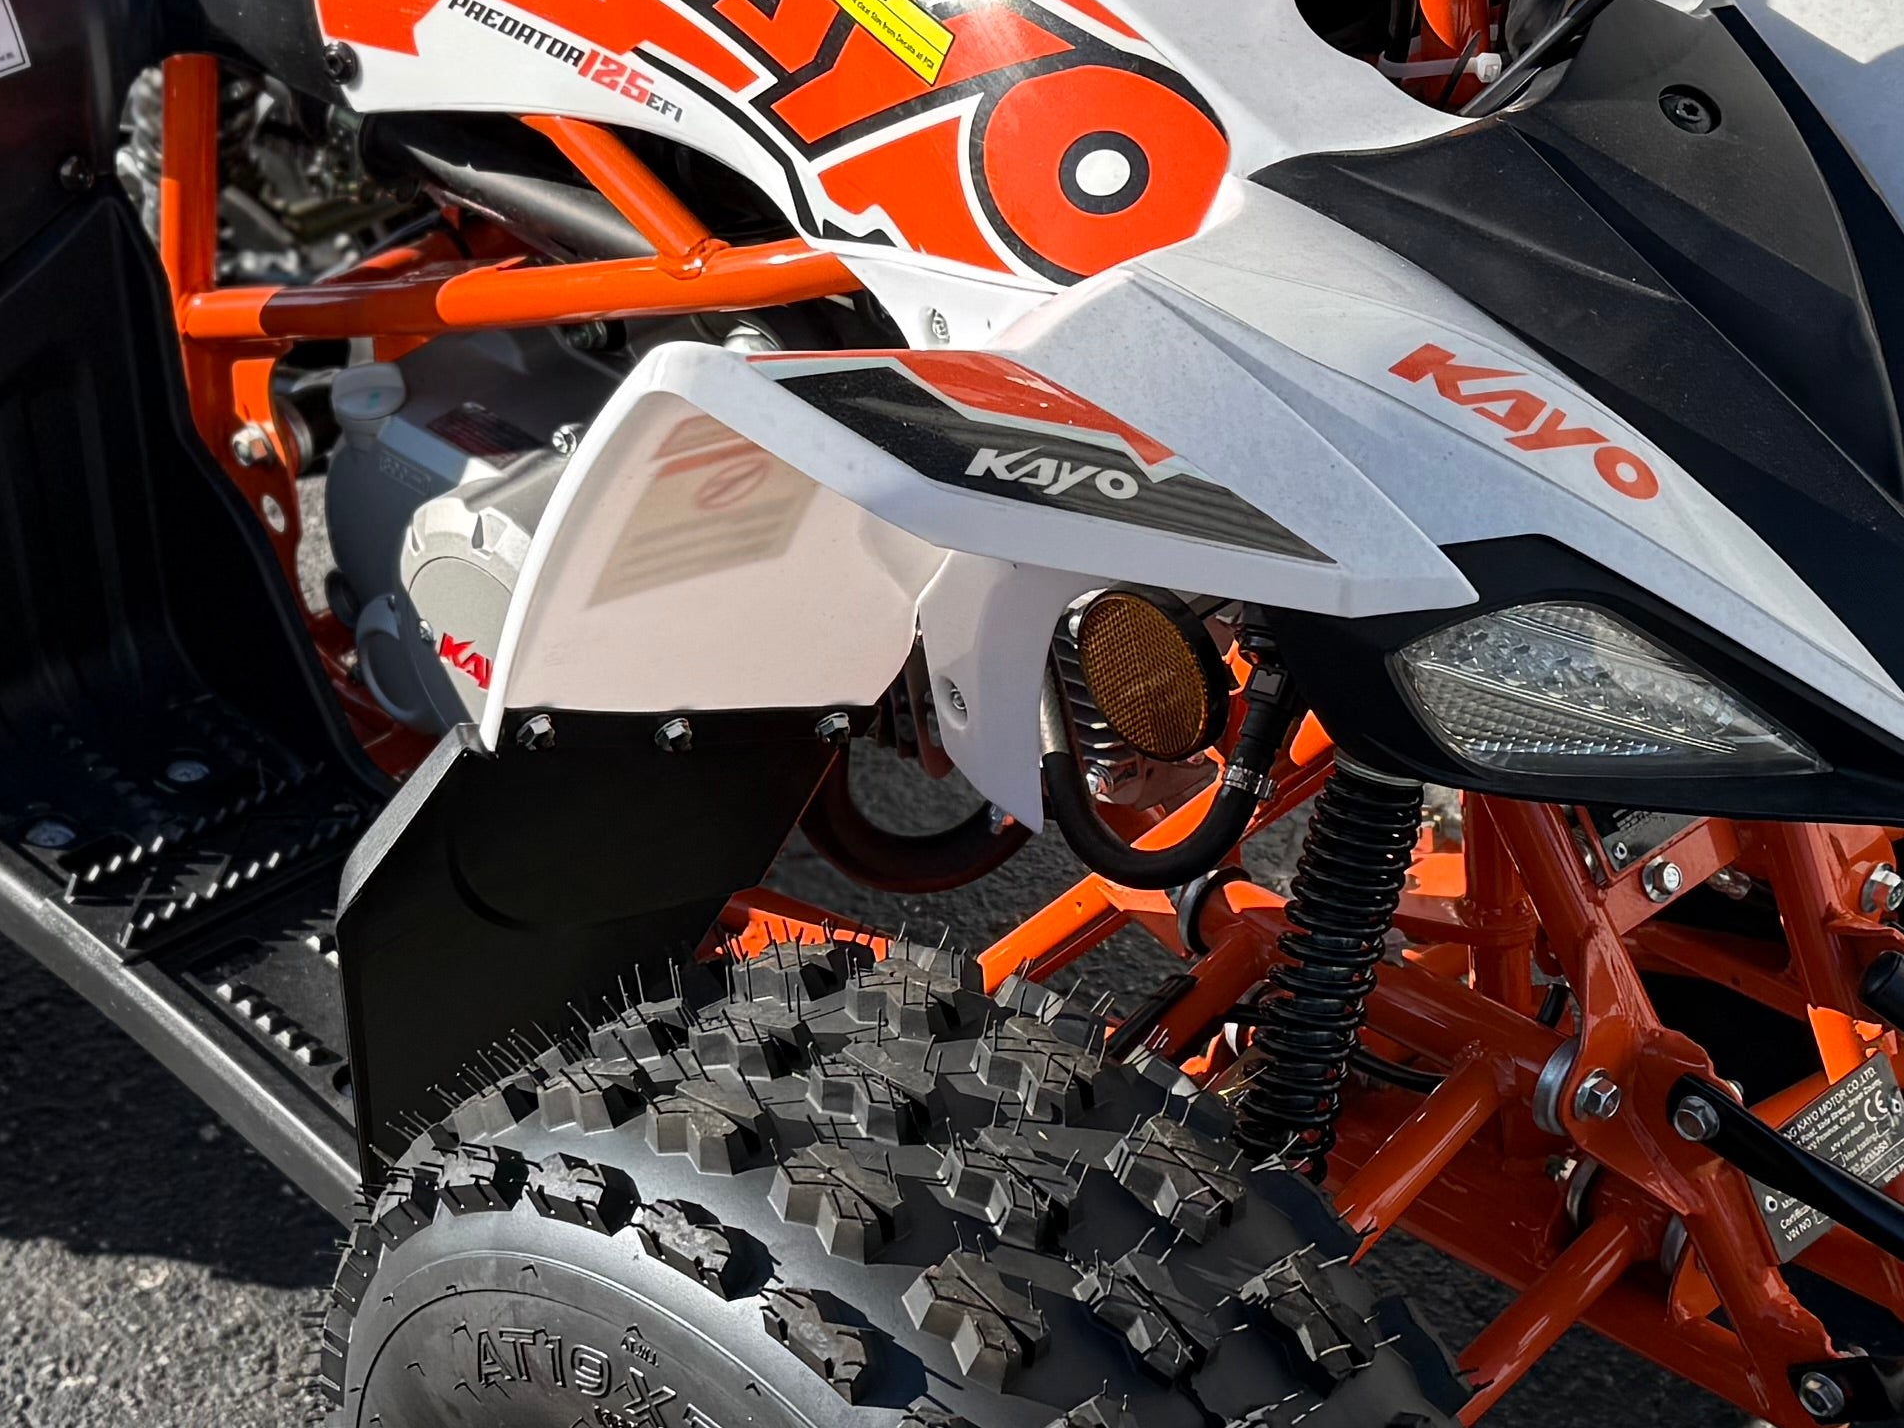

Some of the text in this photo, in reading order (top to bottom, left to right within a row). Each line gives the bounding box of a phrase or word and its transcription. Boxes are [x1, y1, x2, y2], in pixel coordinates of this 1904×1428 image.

[1389, 342, 1660, 500] KAYO
[964, 445, 1141, 502] KAYO
[1797, 1112, 1819, 1133] KAYO
[1818, 1089, 1847, 1116] MOTOR
